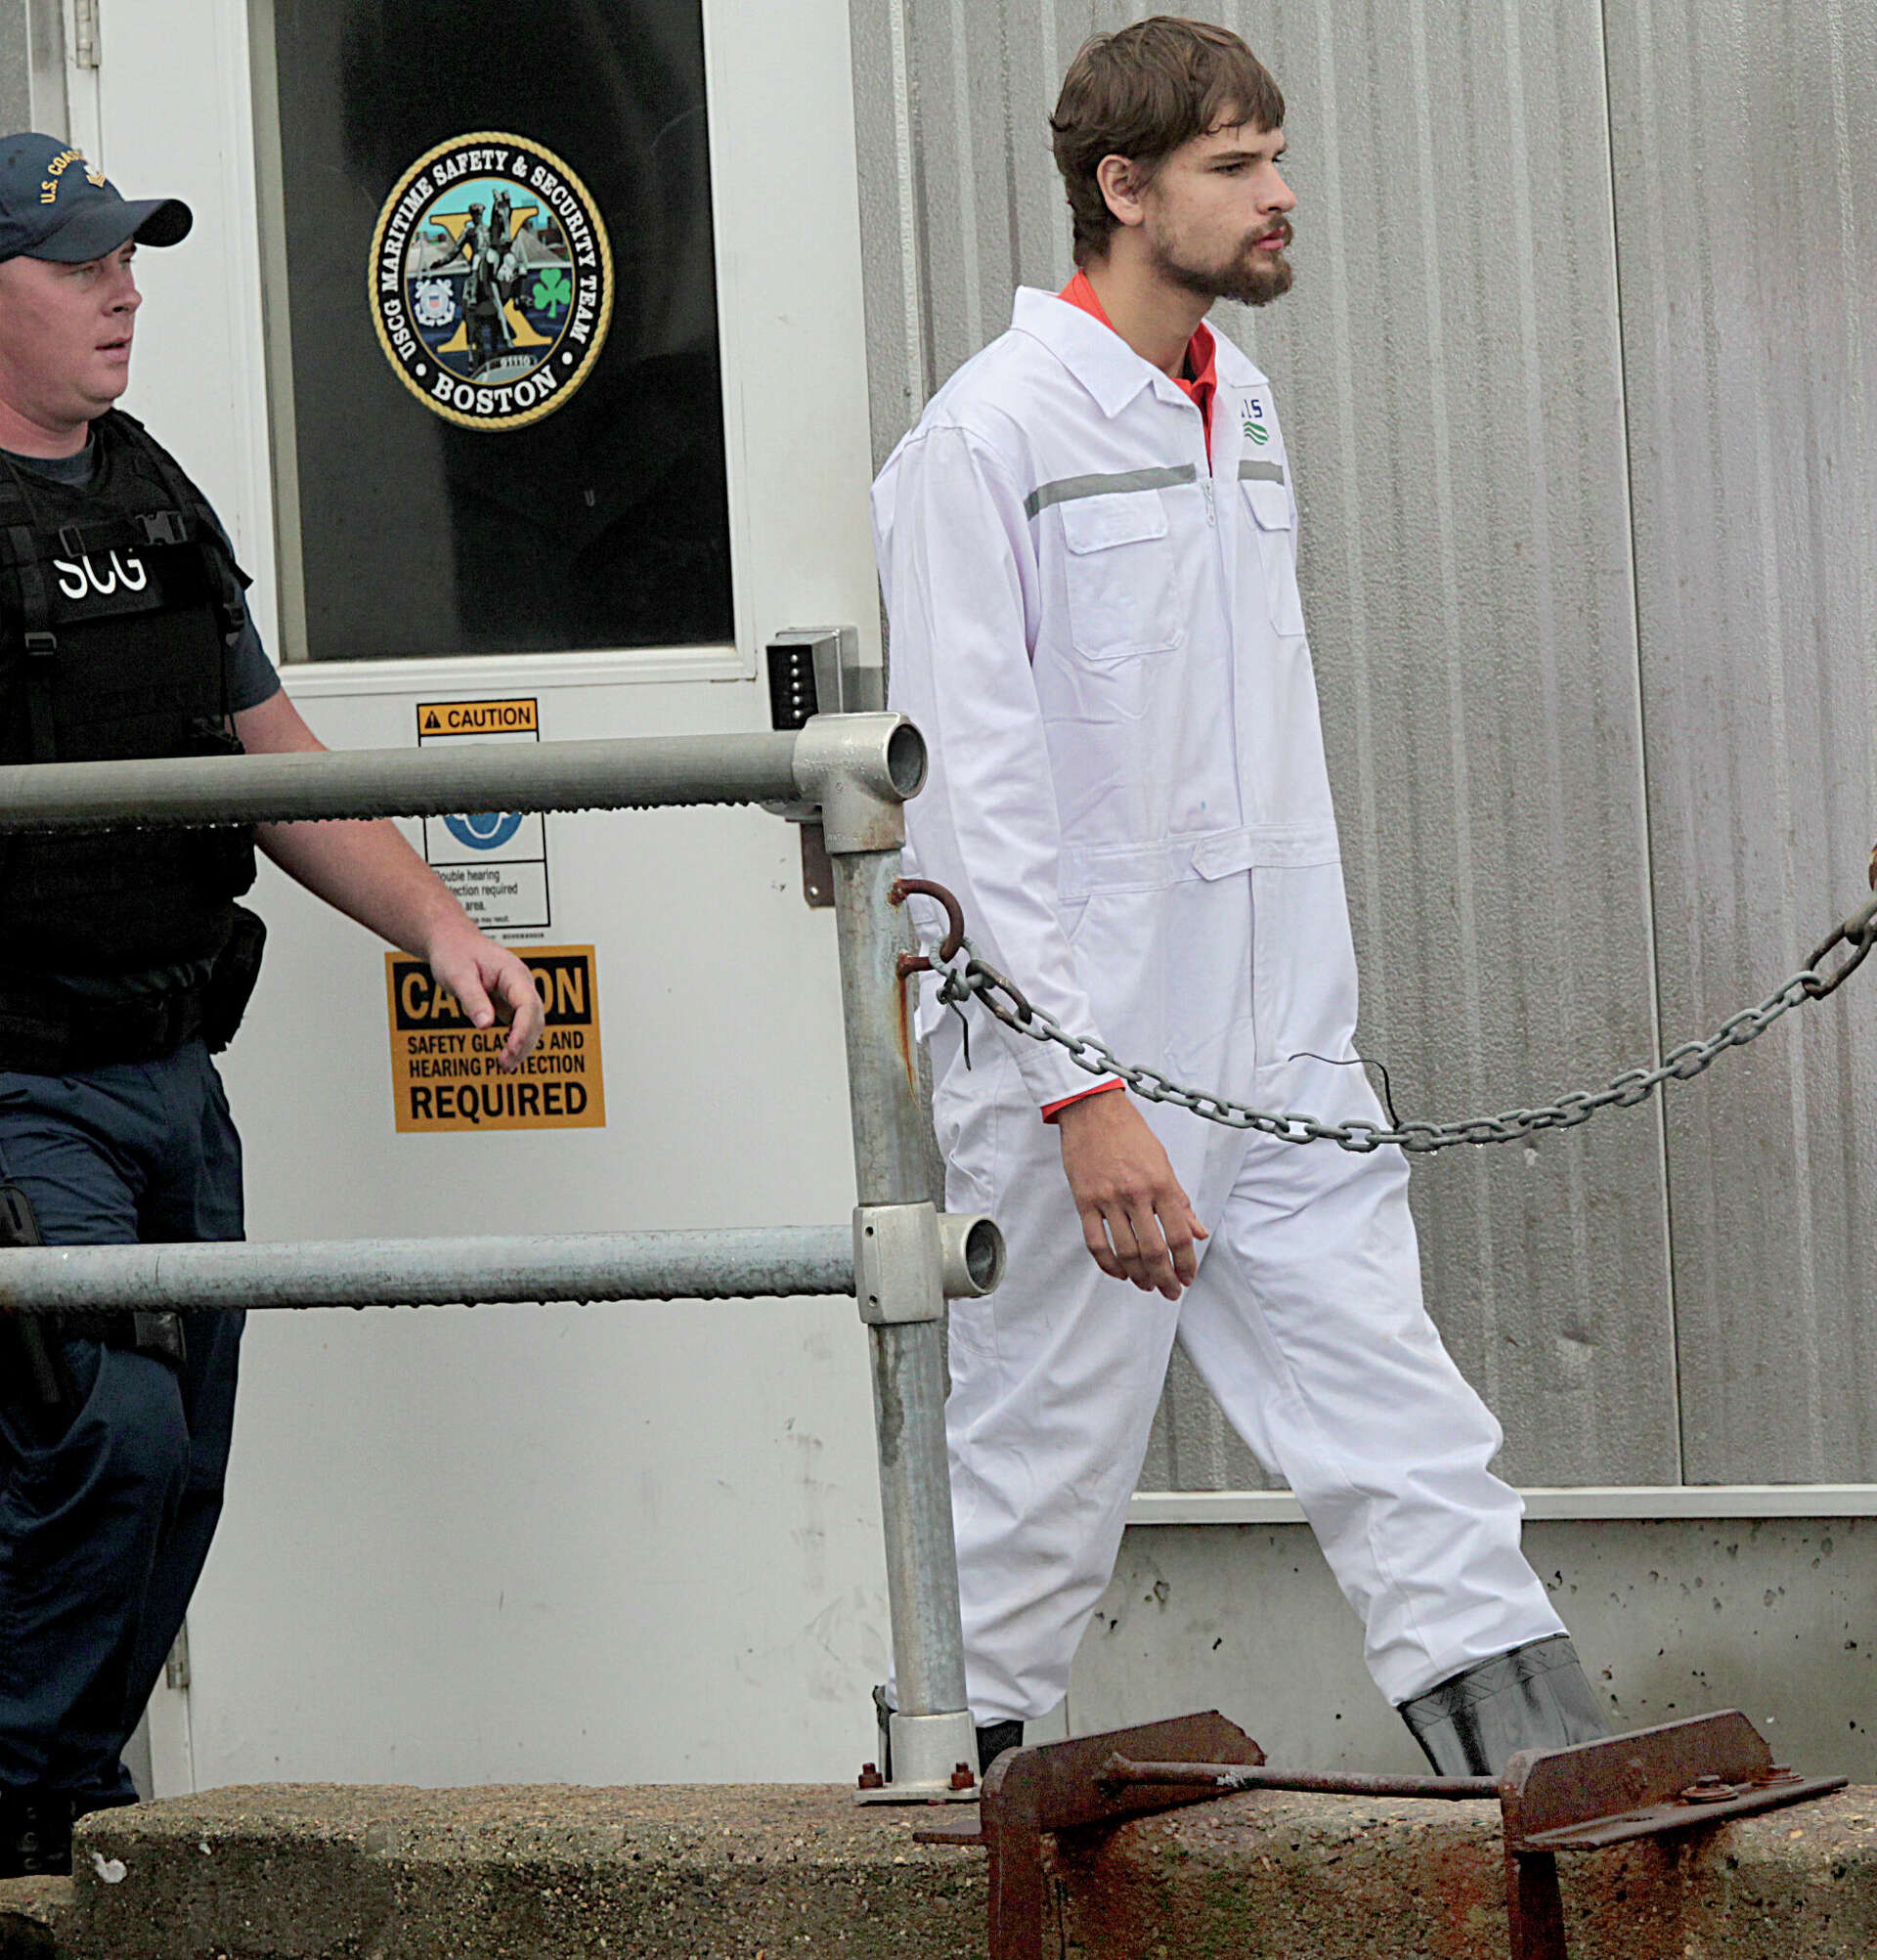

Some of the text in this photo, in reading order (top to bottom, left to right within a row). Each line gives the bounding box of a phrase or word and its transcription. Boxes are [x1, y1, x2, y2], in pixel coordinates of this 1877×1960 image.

[40, 179, 59, 203] U.S.
[381, 150, 597, 361] USCG MARITIME SAFETY & SECURITY TEAM
[431, 365, 558, 414] BOSTON
[448, 707, 532, 728] CAUTION
[467, 869, 501, 883] hearing
[481, 883, 518, 898] required
[401, 967, 586, 1020] CAON
[408, 1034, 466, 1055] SAFETY
[550, 1030, 585, 1051] AND
[409, 1057, 481, 1078] HEARING
[410, 1081, 588, 1124] REQUIRED
